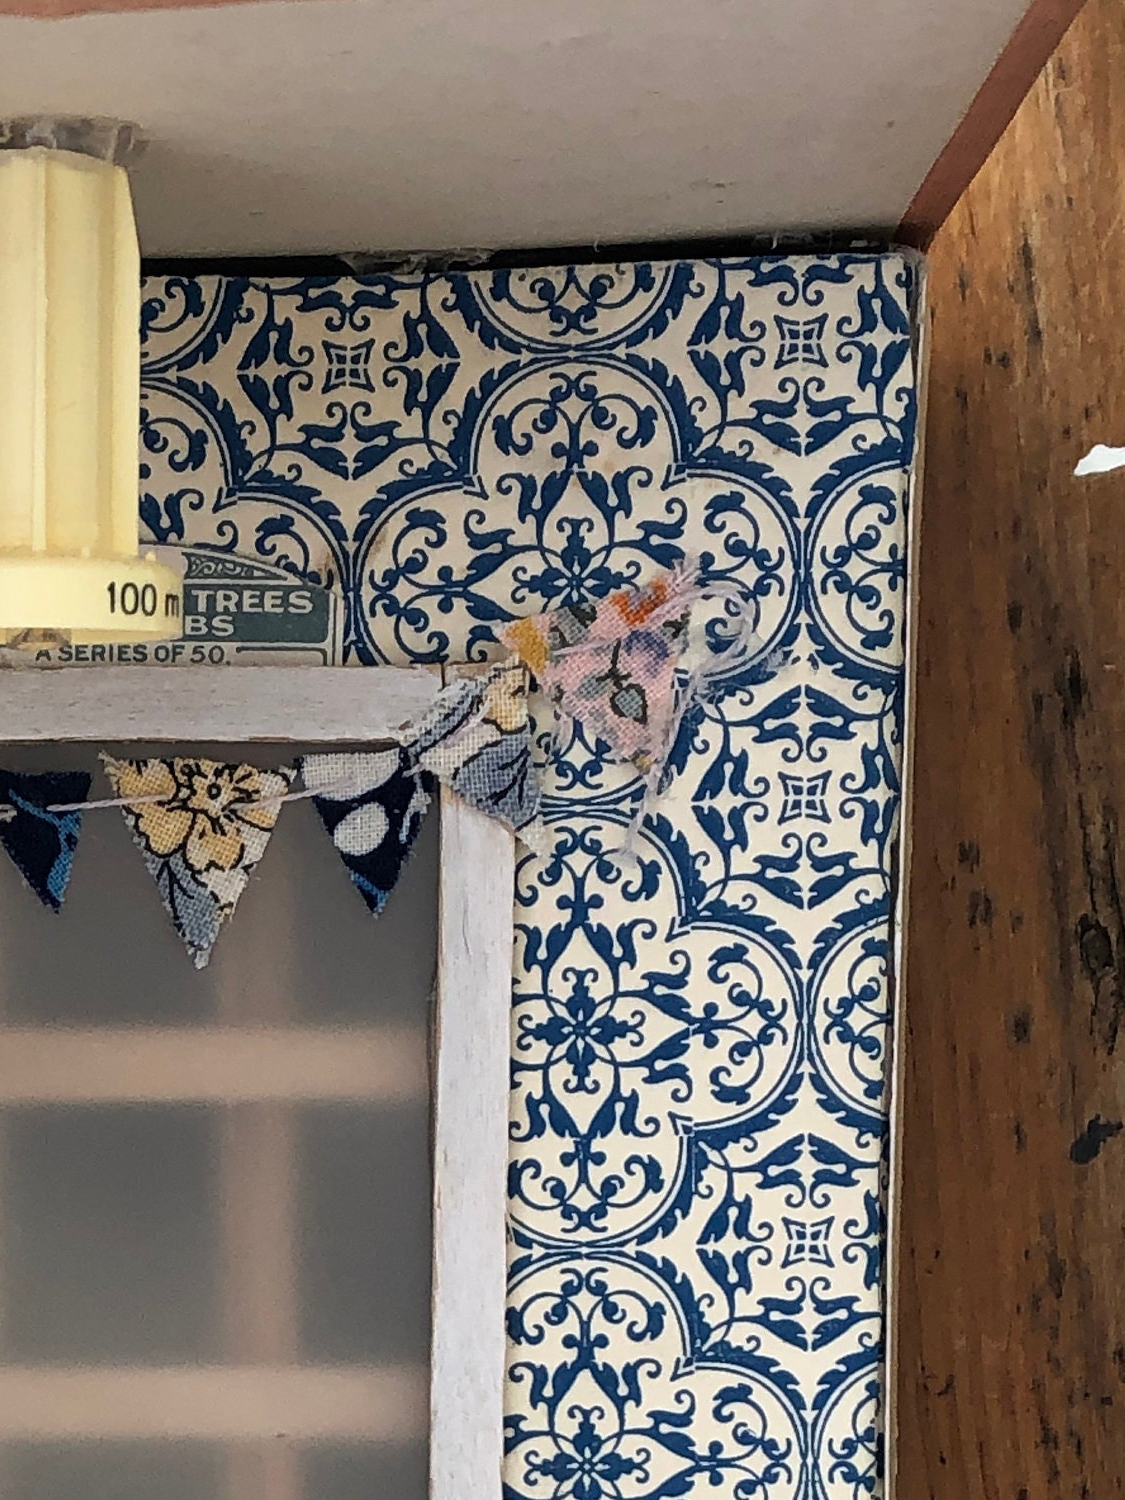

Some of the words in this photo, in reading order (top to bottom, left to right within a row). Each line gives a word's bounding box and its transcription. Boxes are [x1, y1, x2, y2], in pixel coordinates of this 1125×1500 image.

[107, 582, 157, 616] 100
[165, 593, 179, 617] m
[191, 589, 314, 614] TREES
[58, 644, 148, 662] SERIES
[154, 644, 185, 662] OF
[189, 645, 231, 666] 50.
